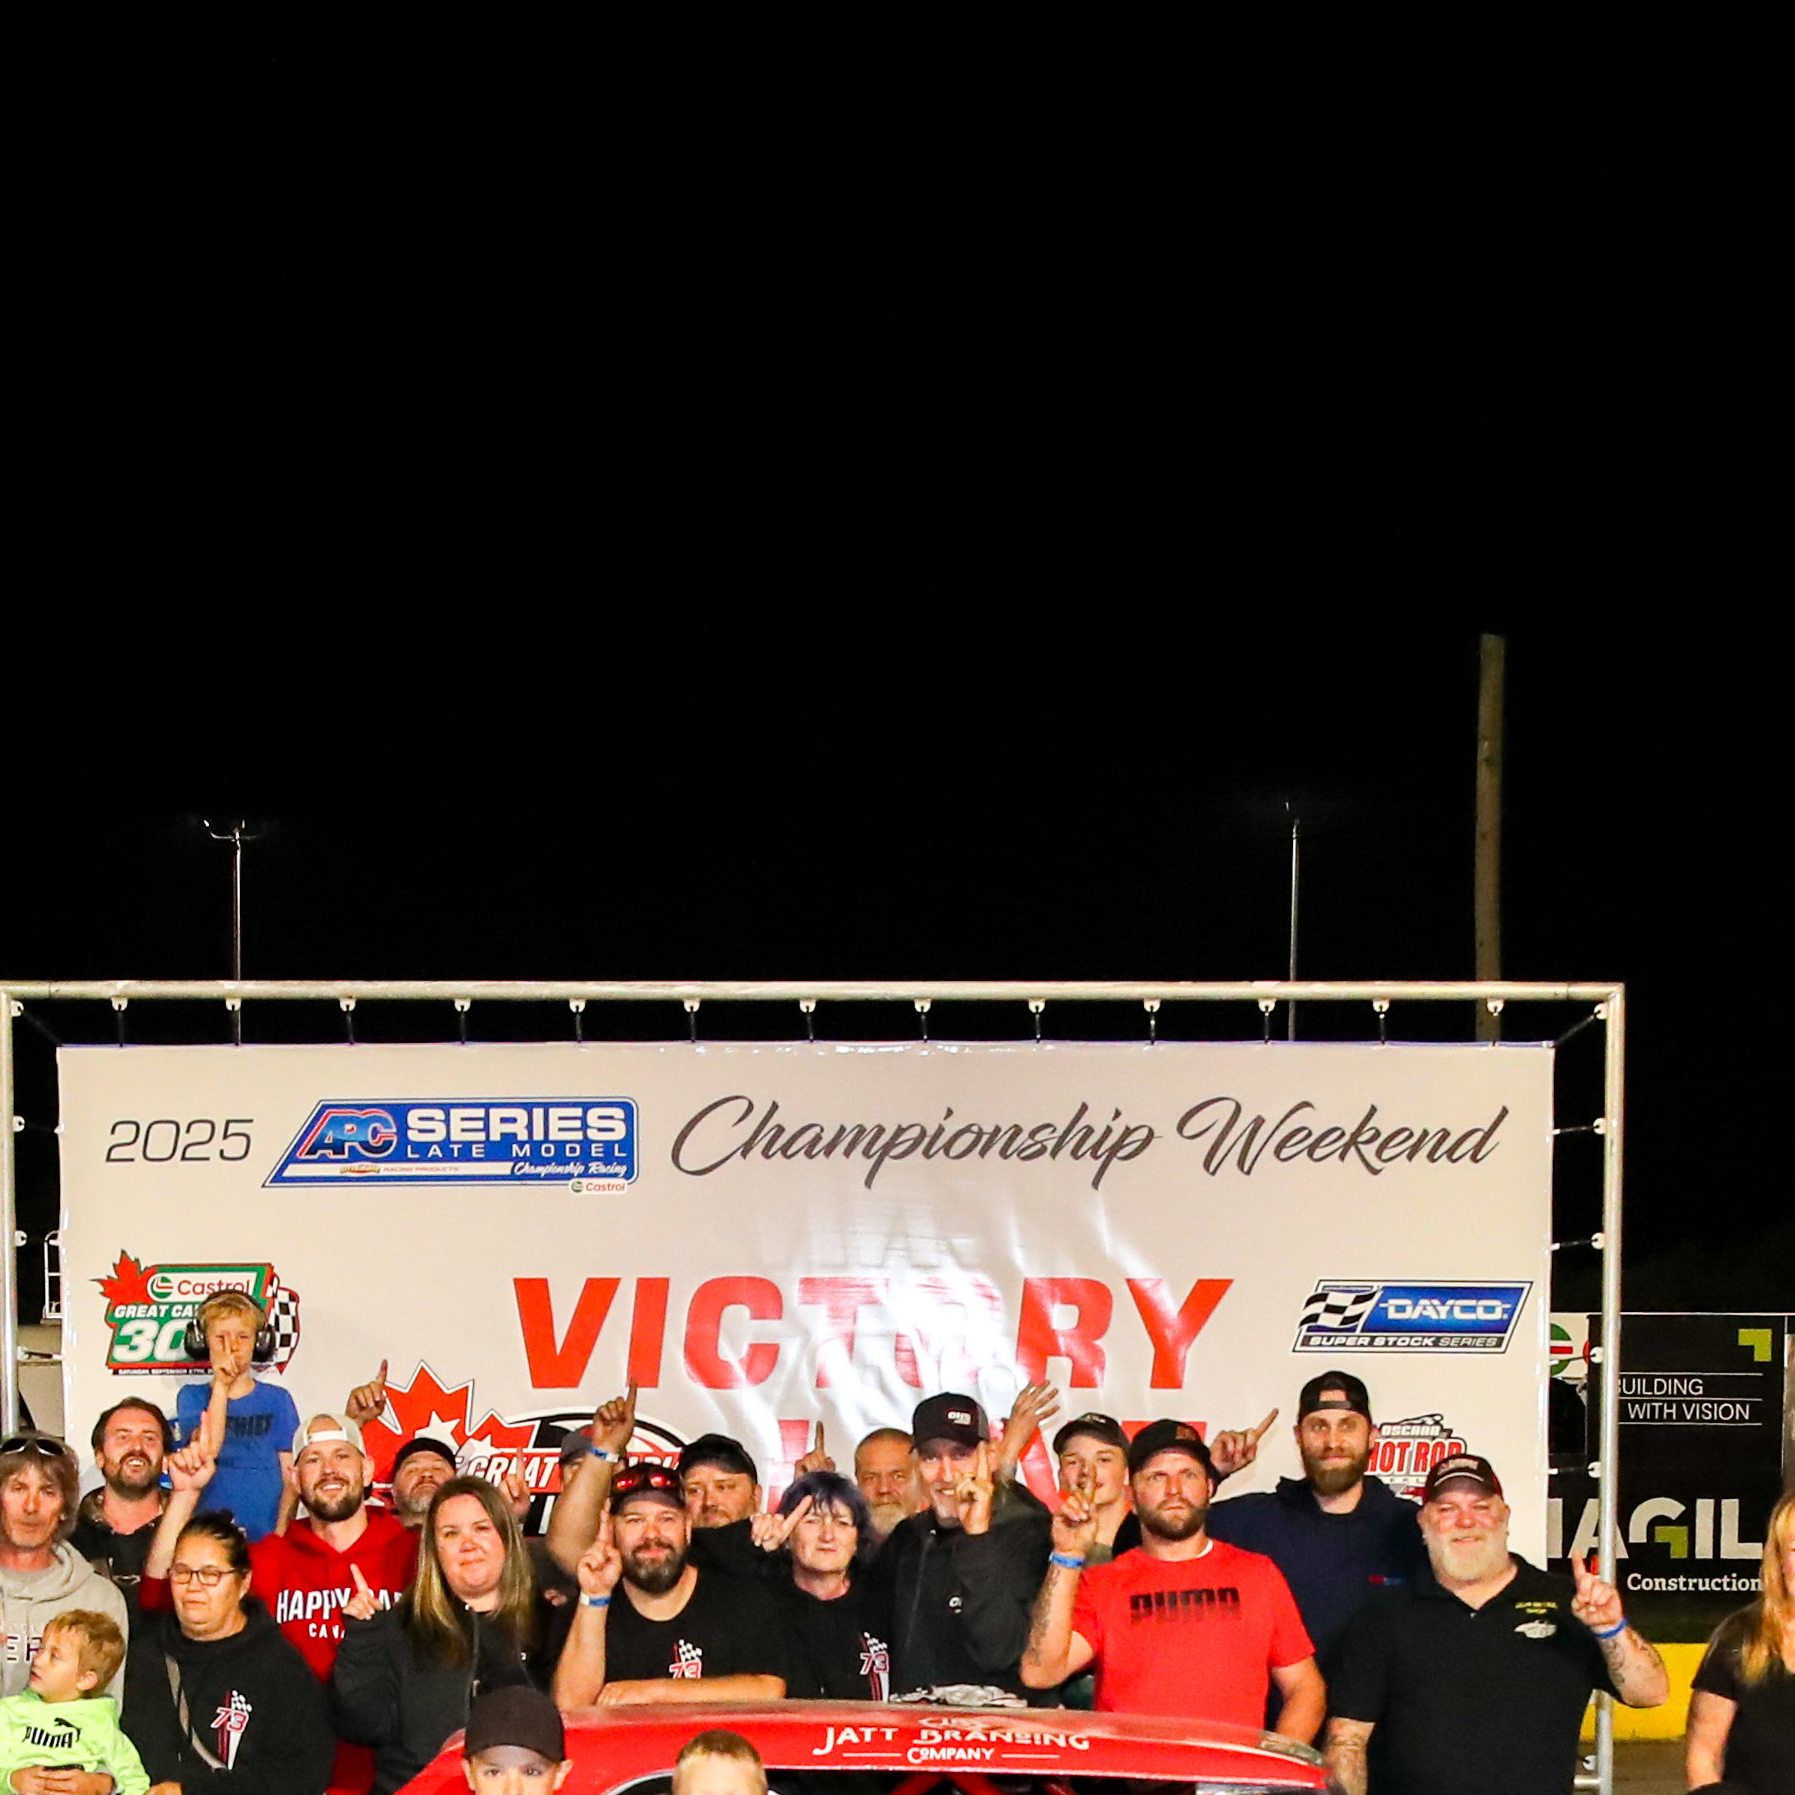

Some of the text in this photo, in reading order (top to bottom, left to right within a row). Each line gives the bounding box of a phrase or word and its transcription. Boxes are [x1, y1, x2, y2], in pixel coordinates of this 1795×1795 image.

[106, 1119, 254, 1163] 2025
[297, 1107, 627, 1159] APC SERIES
[672, 1095, 1510, 1189] Championship Weekend
[407, 1143, 627, 1158] LATE MODEL
[514, 1161, 628, 1177] Championship Racing
[585, 1181, 626, 1192] Castrol
[177, 1280, 251, 1297] Castrol
[114, 1304, 169, 1318] GREAT
[1381, 1299, 1511, 1320] DAYCO
[1309, 1336, 1497, 1347] SUPER STOCK SERIES
[1628, 1403, 1750, 1421] WITH VISION
[466, 1455, 558, 1489] GRAT
[1626, 1572, 1763, 1593] Construction
[277, 1588, 352, 1624] HAPPY
[1129, 1587, 1241, 1625] PUMA
[859, 1651, 890, 1675] 73
[210, 1706, 249, 1734] 73
[25, 1725, 74, 1749] PUMA
[813, 1727, 1091, 1756] JATT BRANDING
[907, 1747, 995, 1764] COMPANY
